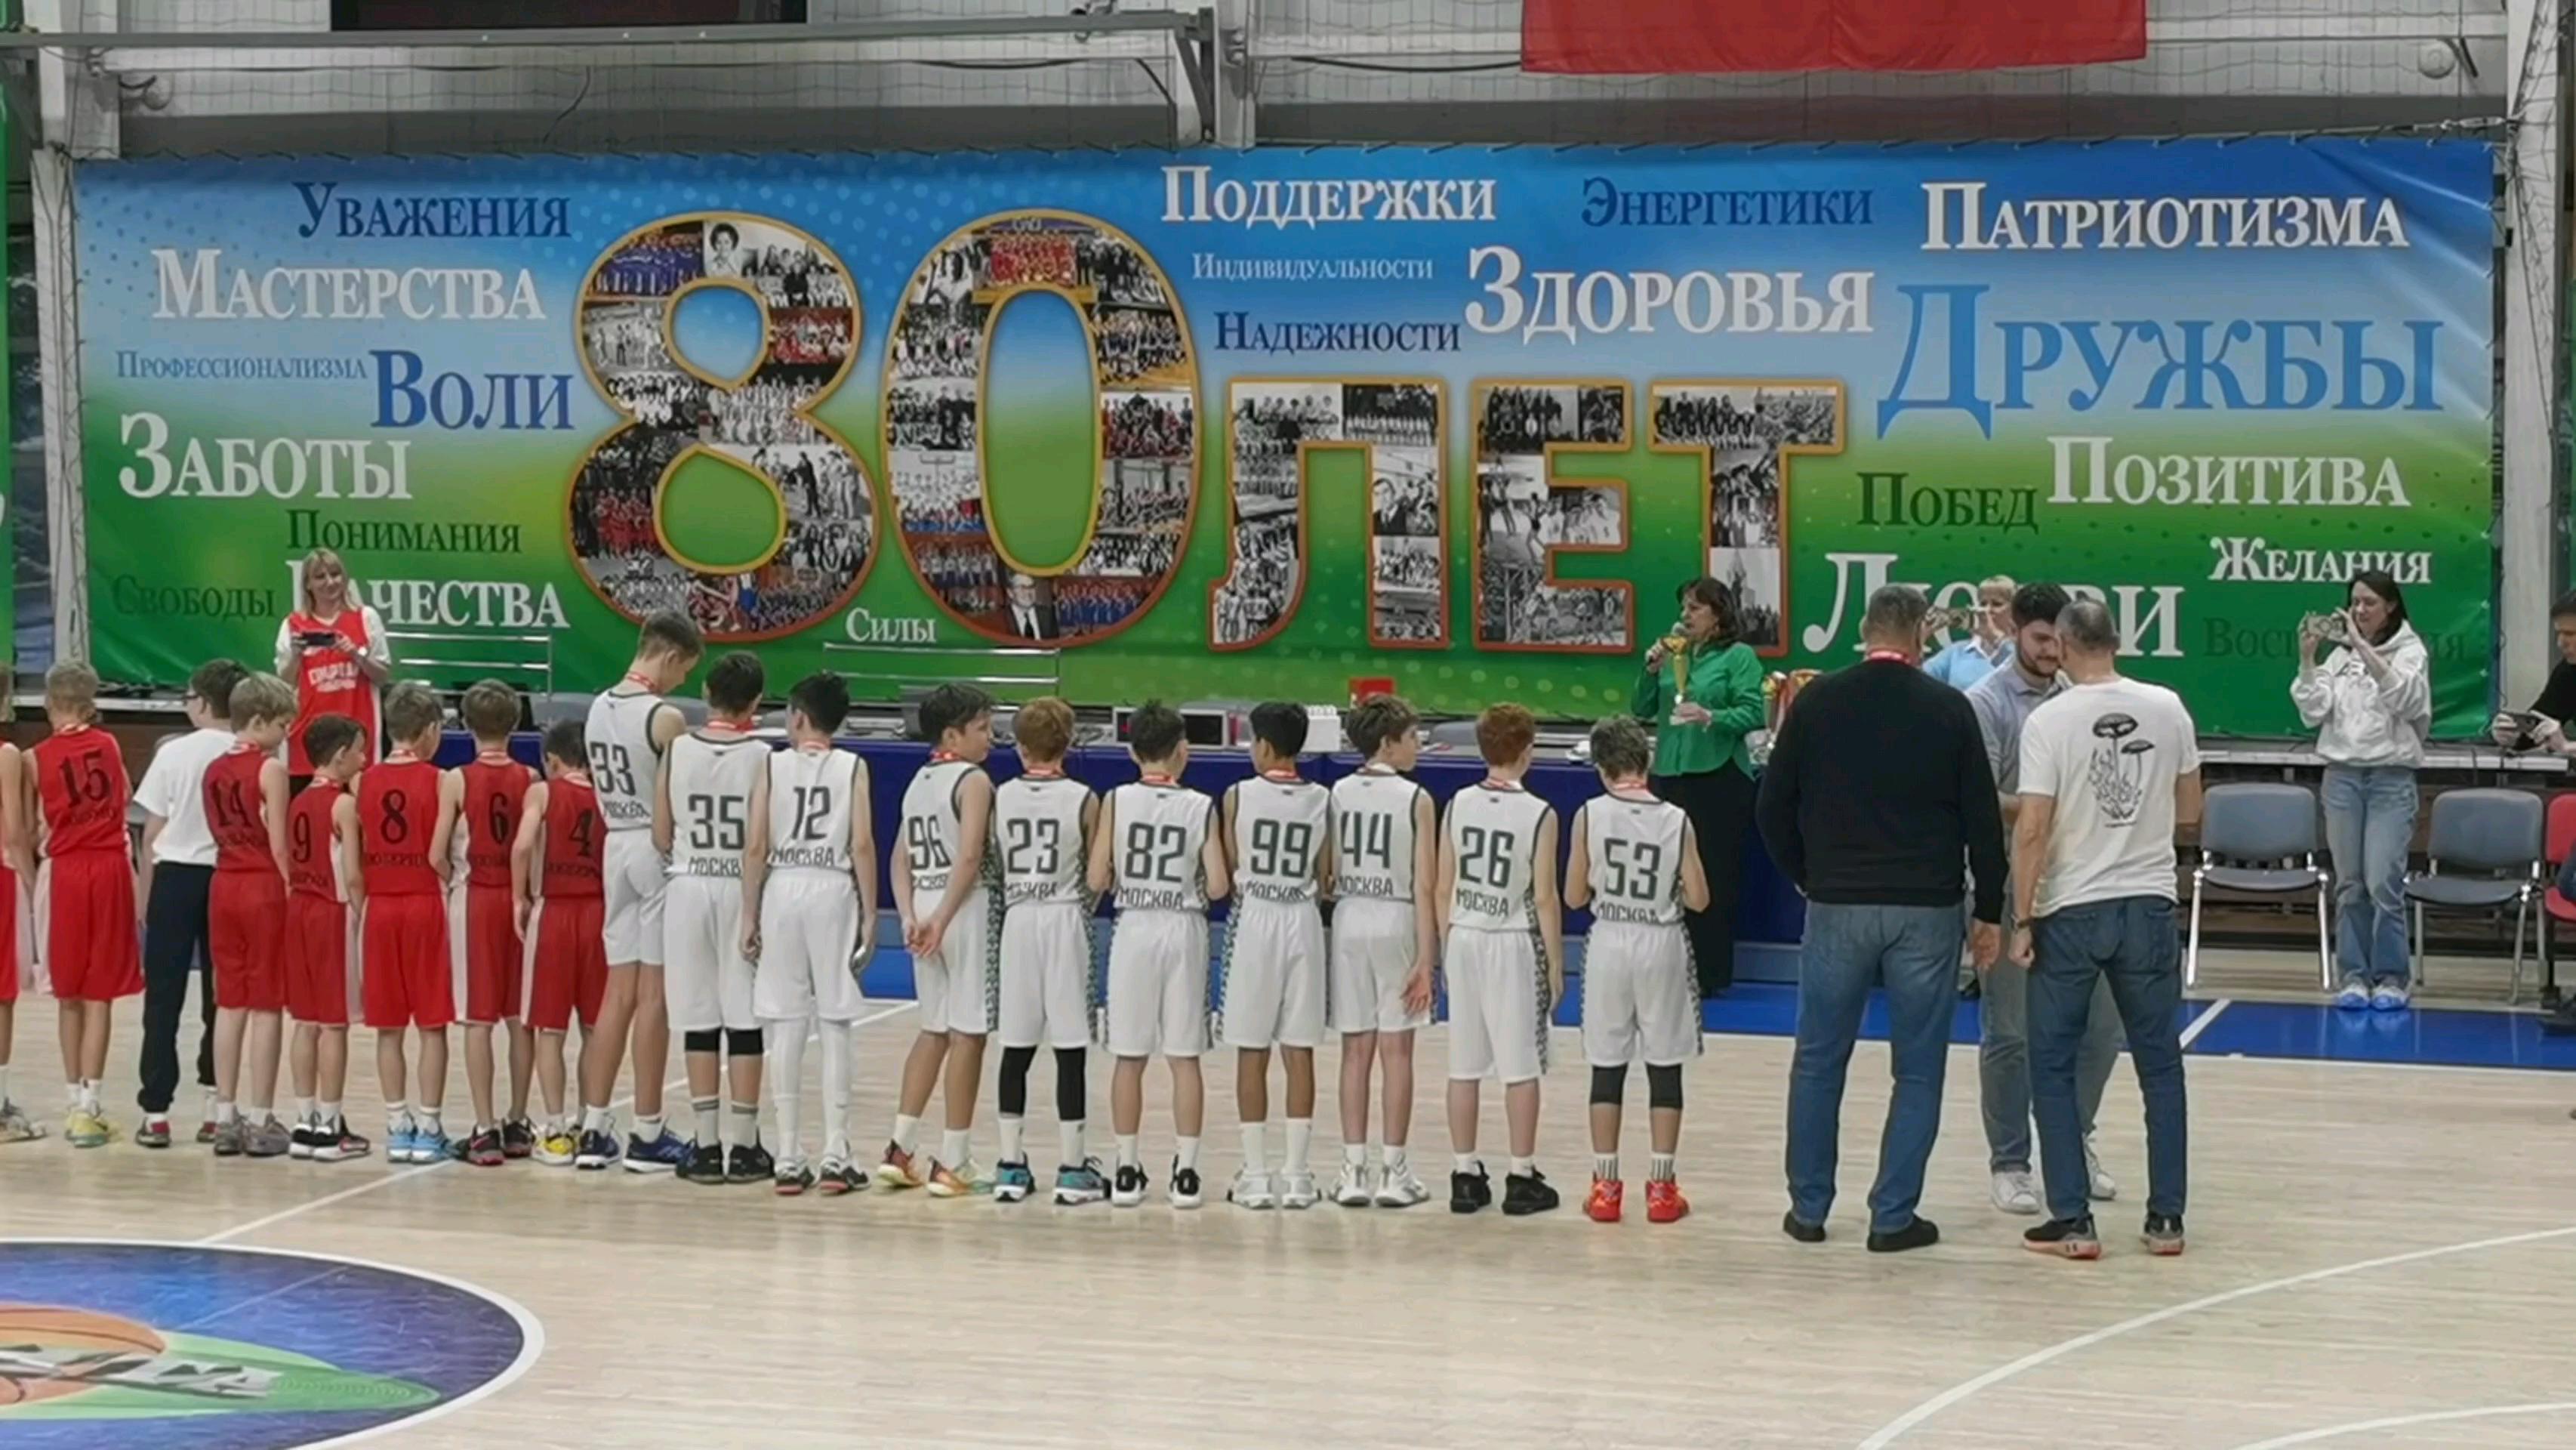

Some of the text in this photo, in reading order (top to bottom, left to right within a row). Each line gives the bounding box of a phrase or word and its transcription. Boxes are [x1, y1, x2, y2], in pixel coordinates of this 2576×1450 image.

[563, 208, 1845, 656] 80 ЛЕТ
[60, 750, 110, 808] 15
[590, 742, 636, 795] 33
[211, 779, 252, 828] 14
[381, 790, 407, 844] 8
[489, 792, 508, 845] 6
[689, 794, 744, 850] 35
[790, 786, 830, 841] 12
[293, 812, 311, 863] 9
[570, 810, 594, 856] 4
[770, 847, 835, 867] МОСКВА
[908, 816, 951, 869] 96
[1006, 818, 1059, 875] 23
[1125, 822, 1187, 883] 82
[1250, 819, 1312, 878] 99
[1341, 811, 1391, 868] 44
[1459, 826, 1514, 889] 26
[1604, 838, 1660, 900] 53
[1118, 887, 1183, 908] МОСКВА
[1456, 887, 1509, 916] МОСКВА
